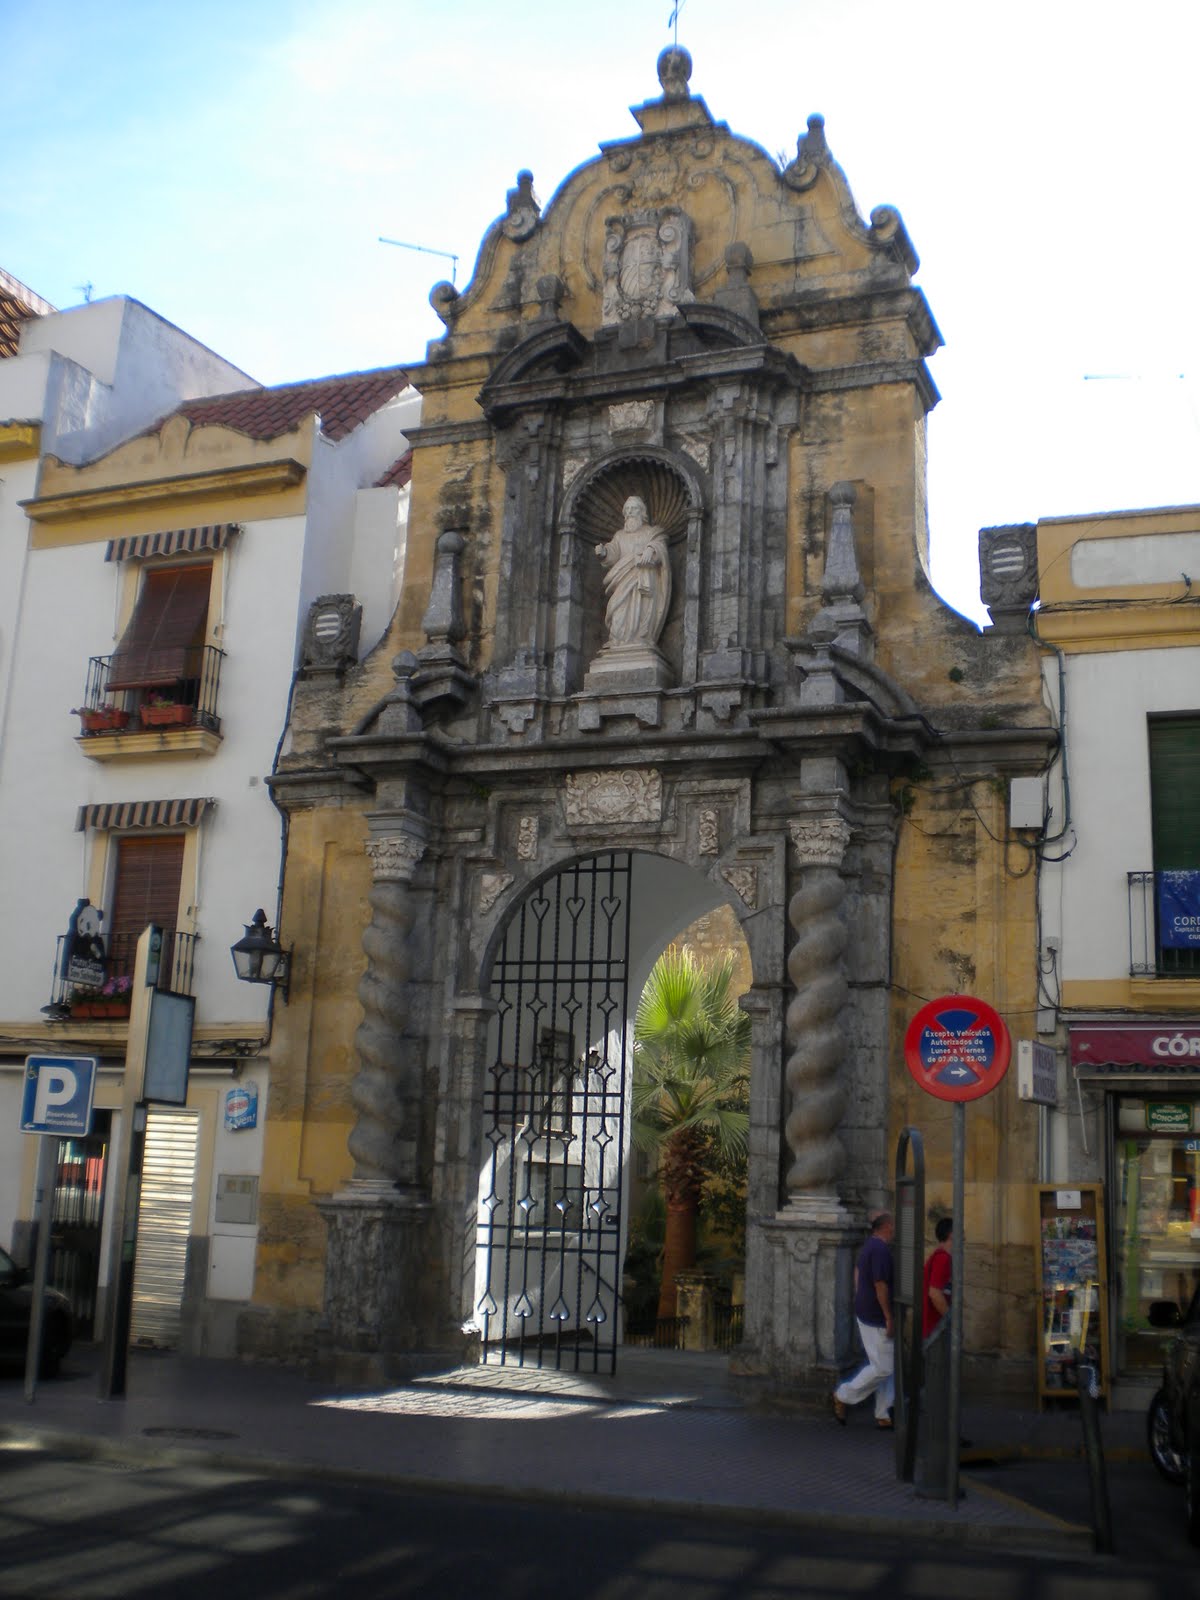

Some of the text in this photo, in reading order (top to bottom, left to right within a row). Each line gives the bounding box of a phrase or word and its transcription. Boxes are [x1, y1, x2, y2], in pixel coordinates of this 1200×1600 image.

[925, 1029, 990, 1038] Excepto Vehículos
[33, 1066, 77, 1123] P
